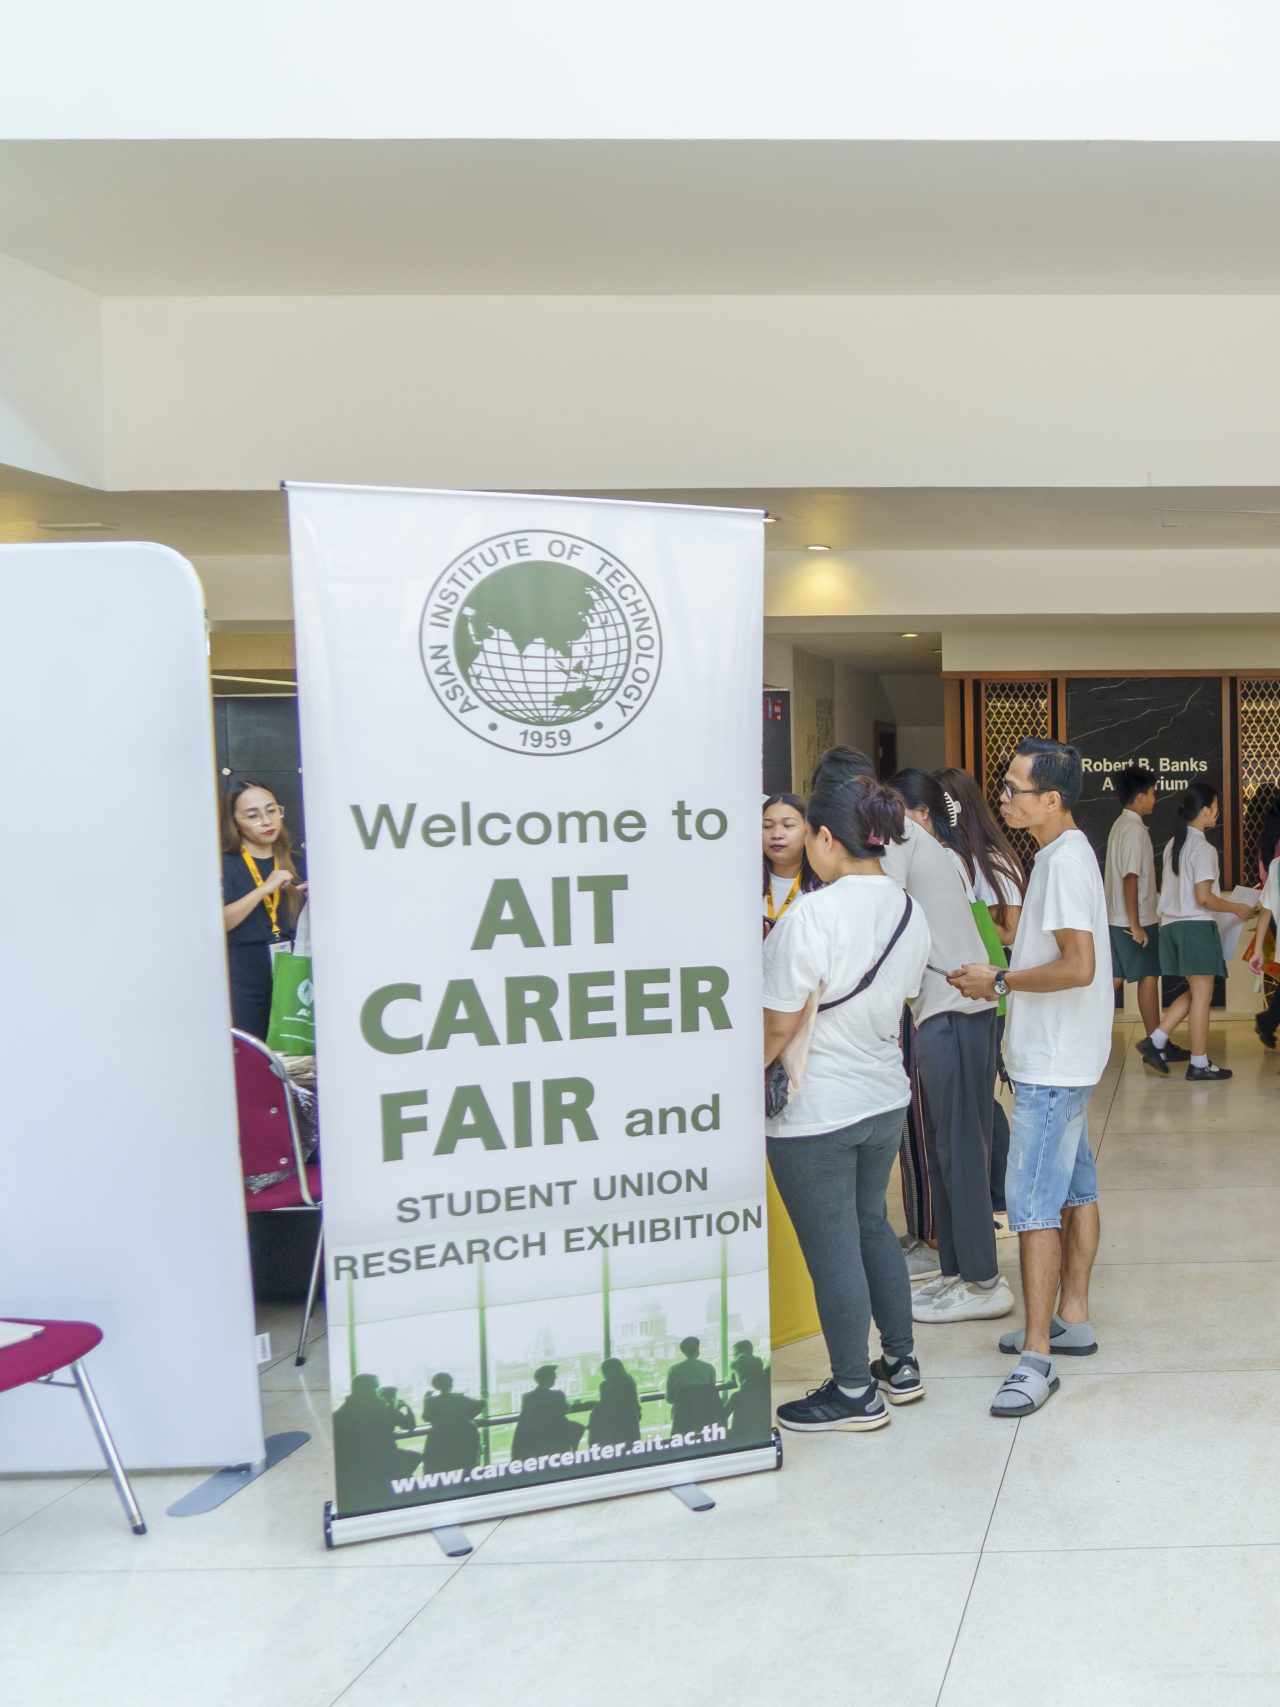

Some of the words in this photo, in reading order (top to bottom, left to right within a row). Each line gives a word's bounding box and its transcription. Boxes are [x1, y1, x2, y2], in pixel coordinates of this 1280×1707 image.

[429, 537, 532, 628] INSTITUTE
[547, 539, 583, 561] OF
[595, 557, 655, 718] TECHNOLOGY
[428, 644, 480, 715] ASIAN
[519, 729, 572, 749] 1959
[1081, 758, 1134, 772] Robert
[1159, 757, 1208, 772] Banks
[351, 802, 646, 850] Welcome
[671, 801, 728, 840] to
[470, 875, 628, 950] AIT
[360, 966, 732, 1054] CAREER
[380, 1077, 598, 1162] FAIR
[625, 1094, 721, 1137] and
[396, 1180, 577, 1223] STUDENT
[593, 1167, 708, 1200] UNION
[334, 1232, 546, 1280] RESEARCH
[563, 1205, 762, 1252] EXHIBITION
[391, 1423, 727, 1495] www.careercenter.ait.ac.th
